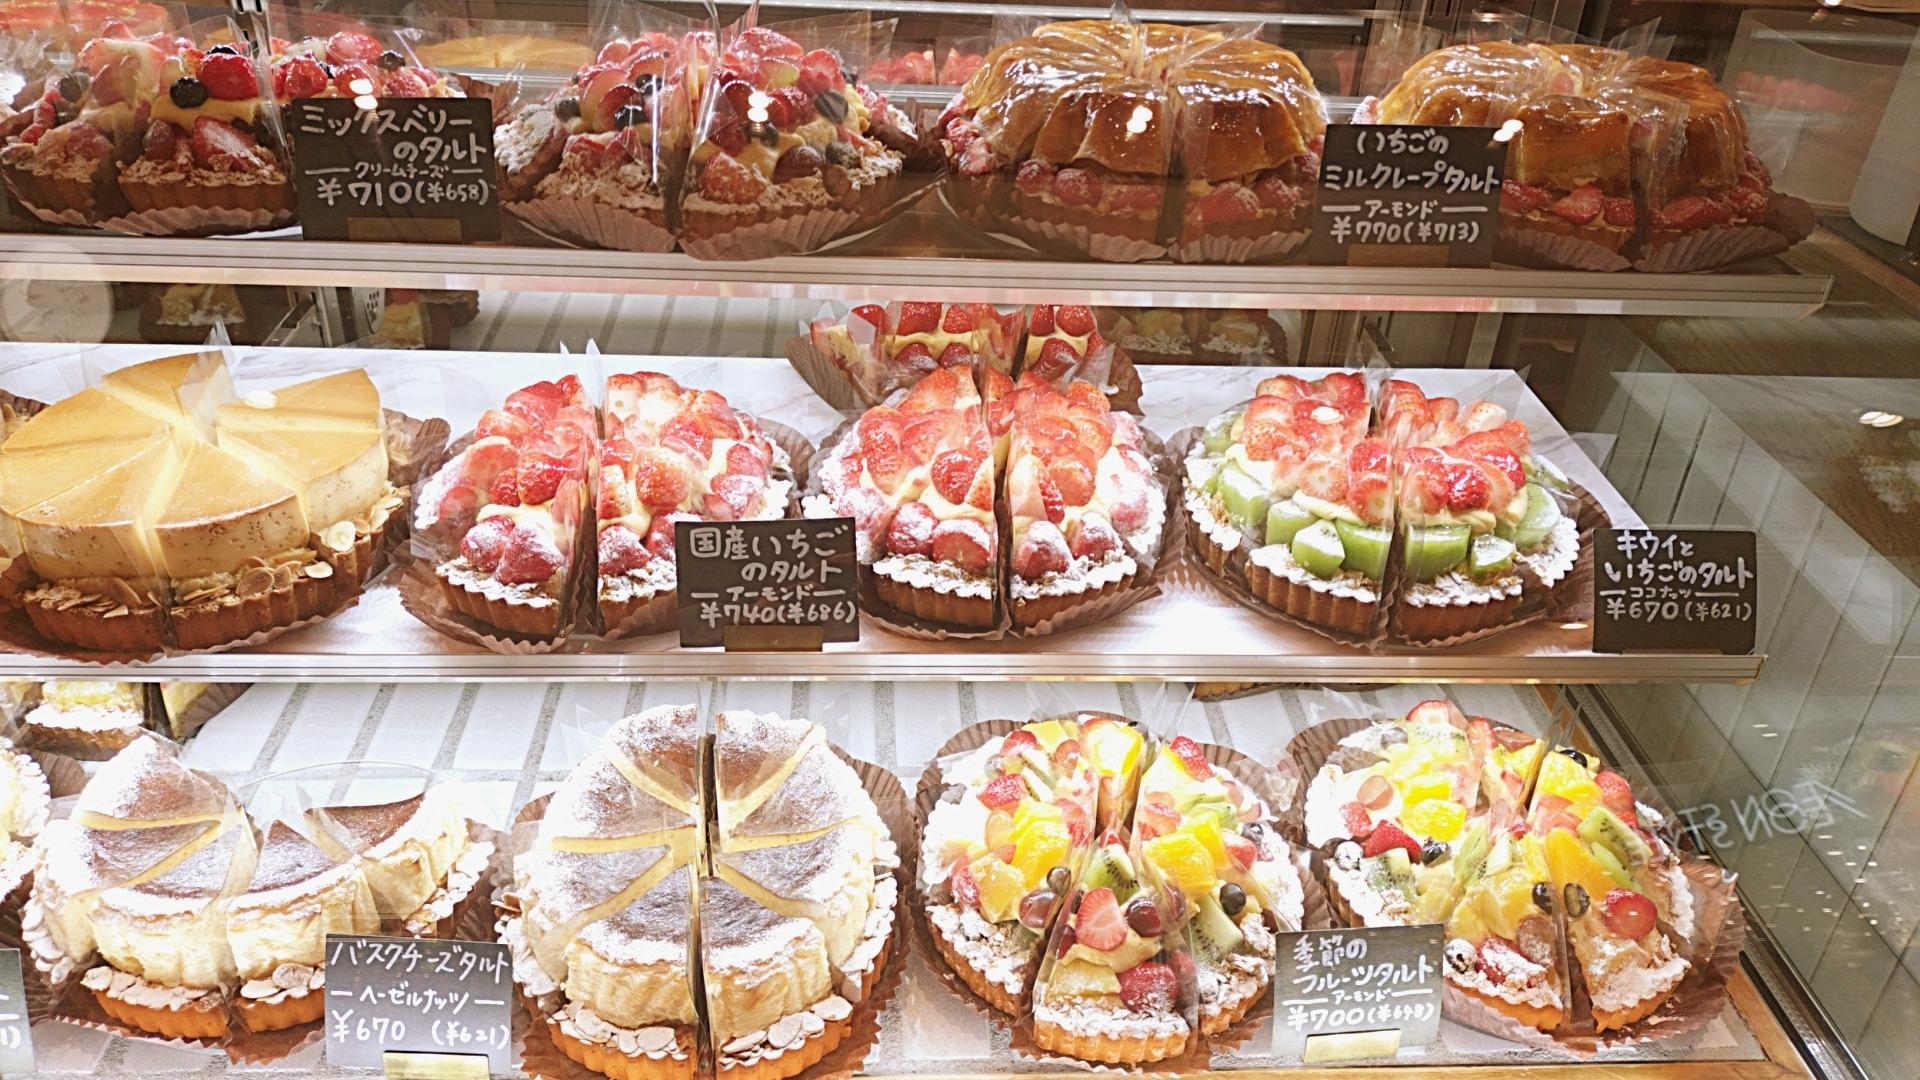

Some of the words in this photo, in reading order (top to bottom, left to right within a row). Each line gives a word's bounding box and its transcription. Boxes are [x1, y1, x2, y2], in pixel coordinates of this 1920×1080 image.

[301, 104, 472, 136] ミックスベリー
[393, 133, 487, 164] のタルト
[1357, 128, 1449, 154] いちごの
[354, 161, 450, 179] クリームチーズ
[1324, 160, 1500, 194] ミルクレープタルト
[1365, 200, 1438, 220] アーモンド
[690, 524, 848, 560] 国産いちご
[1617, 529, 1694, 560] キウイと
[741, 559, 842, 584] のタルト
[1604, 557, 1754, 589] いちごのタルト
[726, 584, 814, 602] アーモンド
[1630, 586, 1692, 600] ココナッツ
[330, 939, 509, 984] バスクチーズタルト
[1293, 934, 1368, 972] 季節の
[1292, 954, 1434, 994] フルーツタルト
[360, 980, 470, 1014] ヘーゼルナッツ
[1332, 988, 1392, 1005] アーモンド
